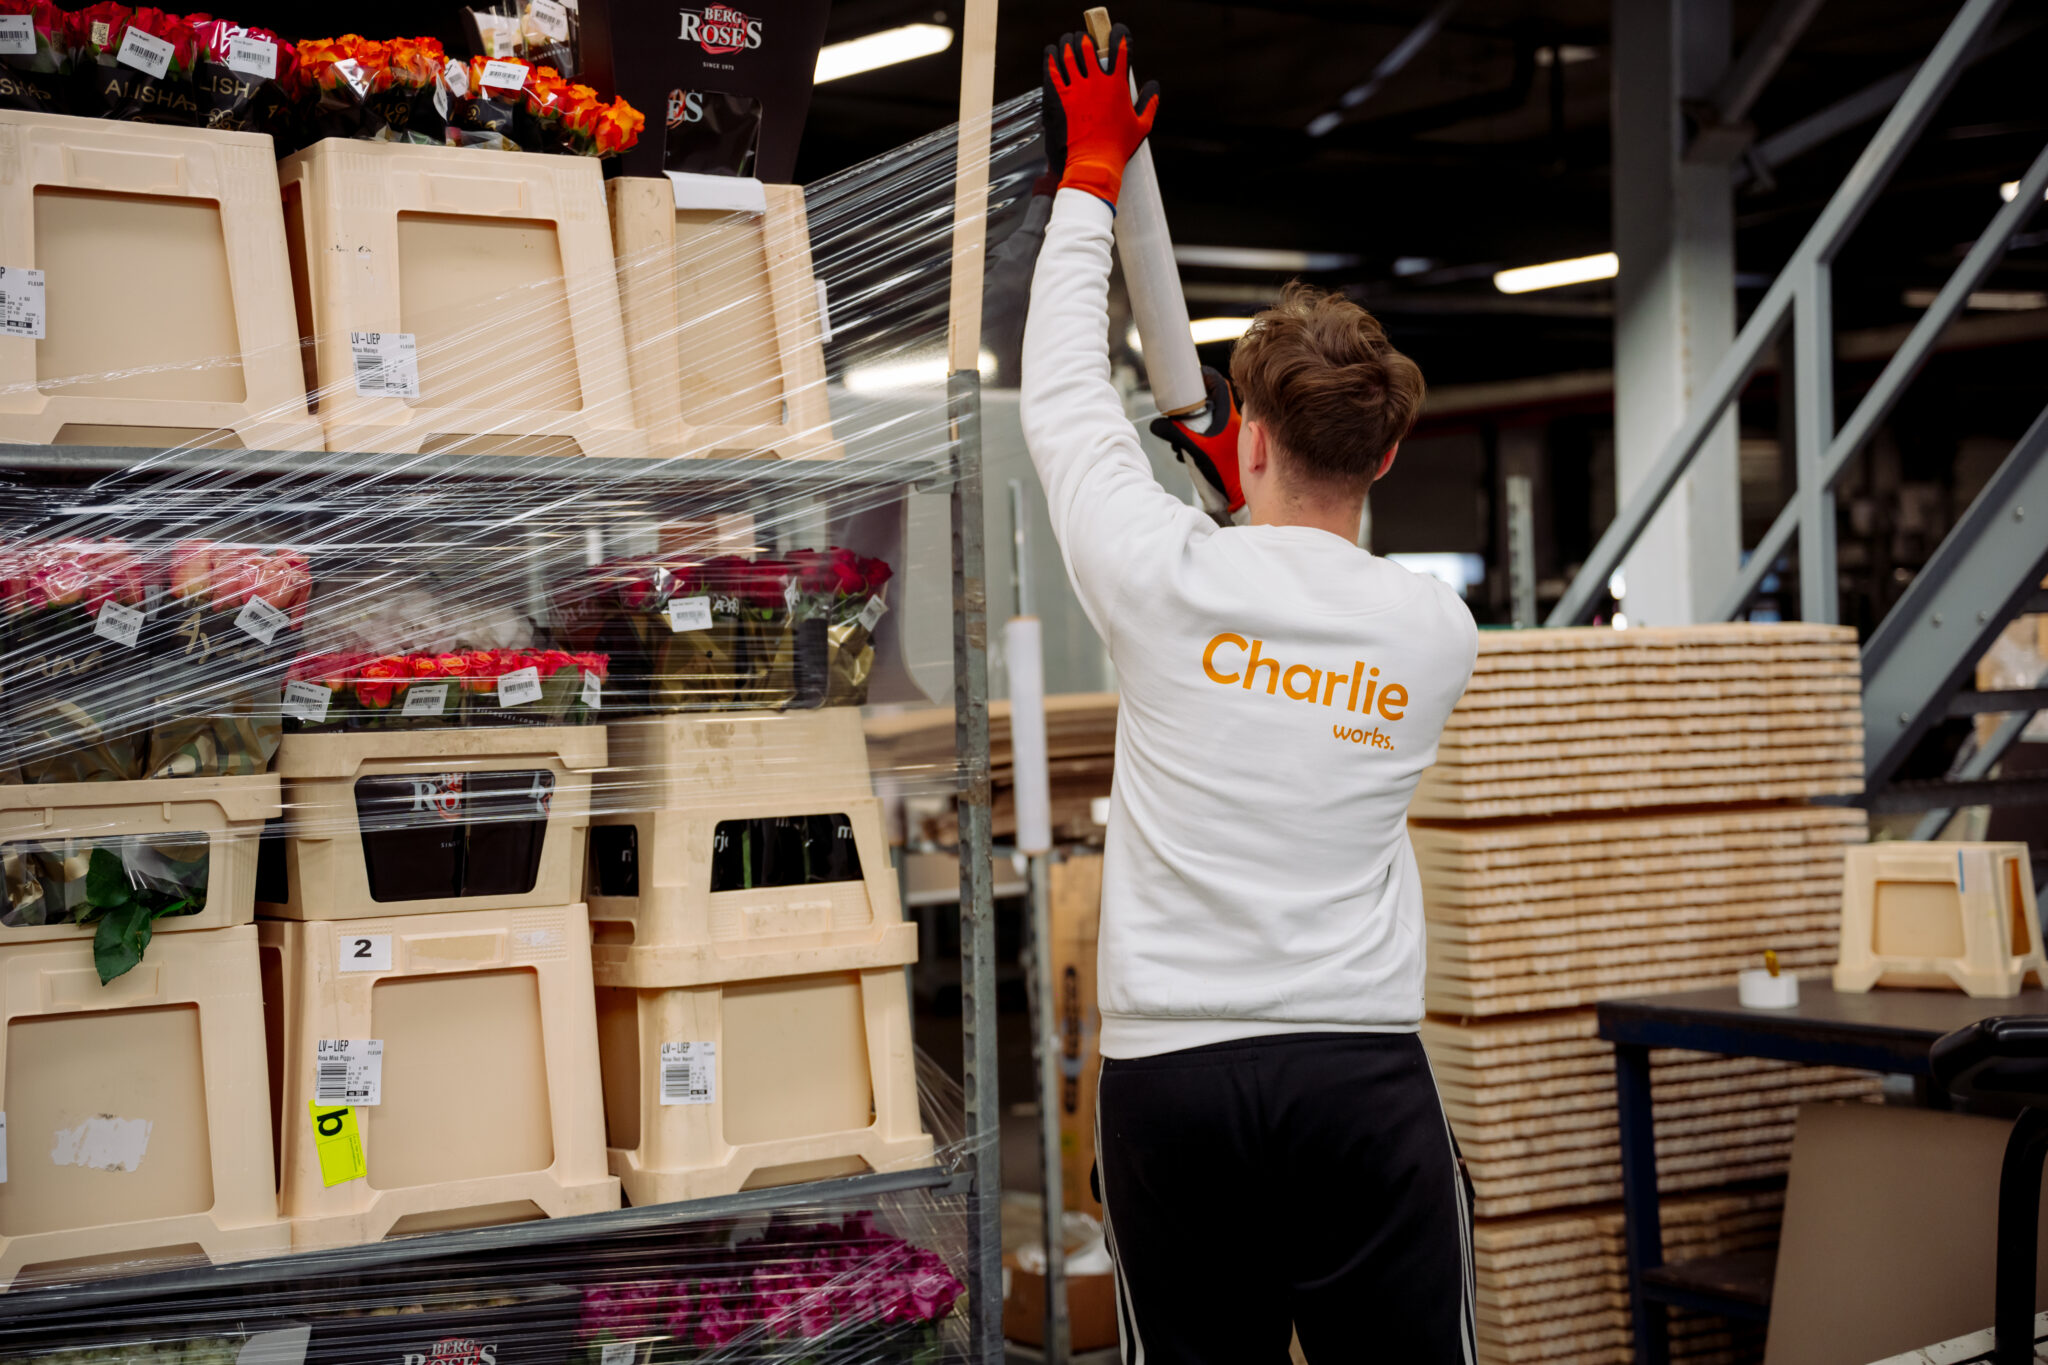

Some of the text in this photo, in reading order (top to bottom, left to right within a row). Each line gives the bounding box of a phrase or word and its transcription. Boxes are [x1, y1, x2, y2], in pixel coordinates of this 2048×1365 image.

[704, 7, 743, 24] BERG
[678, 12, 763, 49] ROSES
[1202, 632, 1409, 721] Charlie
[1333, 724, 1395, 751] works.
[354, 939, 372, 958] 2
[431, 1339, 476, 1356] BERG
